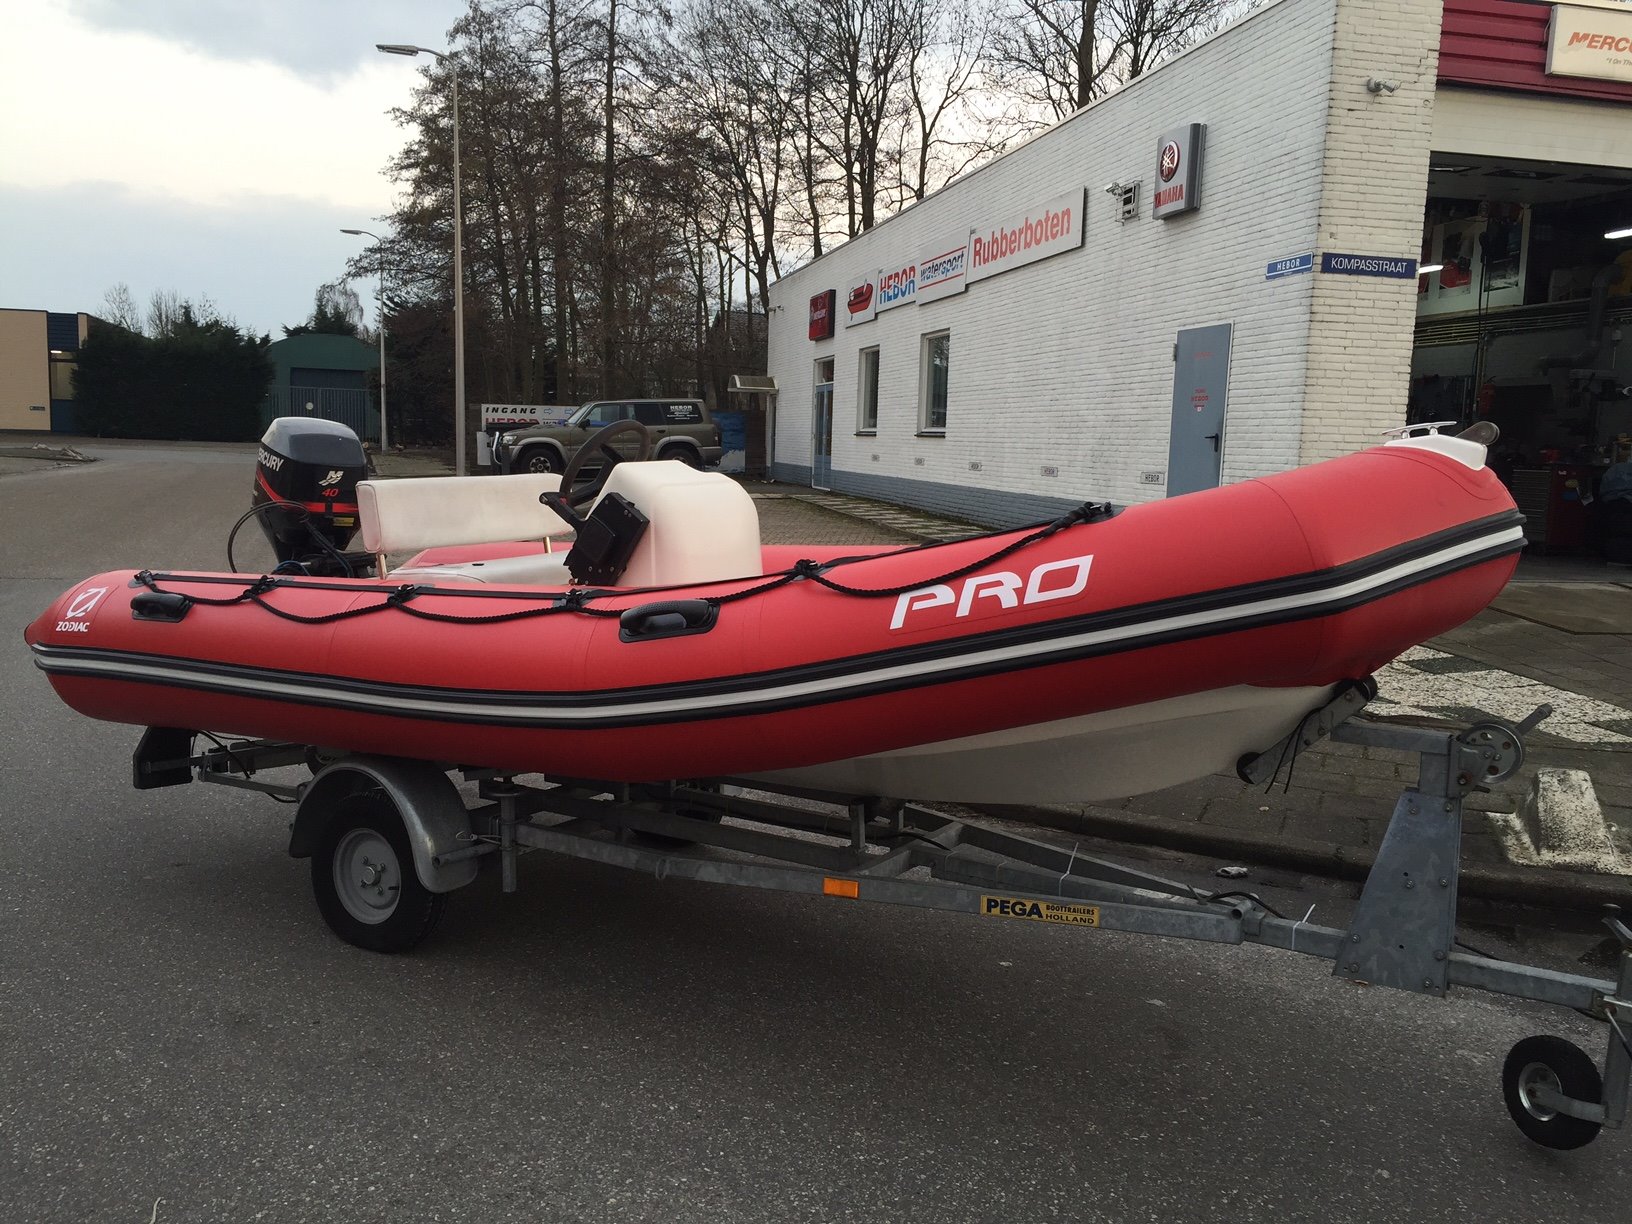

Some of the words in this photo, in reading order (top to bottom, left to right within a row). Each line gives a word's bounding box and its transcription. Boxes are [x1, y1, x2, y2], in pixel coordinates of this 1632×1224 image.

[1568, 31, 1632, 53] MERC
[973, 207, 1071, 268] Rubberboten
[920, 250, 965, 281] watersport
[1276, 258, 1300, 271] HEBOR
[1331, 257, 1408, 274] KOMPASSTRAAT
[880, 265, 916, 304] HEBOR
[485, 406, 537, 415] INGANG
[322, 488, 339, 497] 40
[889, 554, 1094, 629] PRO
[55, 621, 90, 632] ZODIAC
[986, 898, 1044, 919] PEGA
[1046, 904, 1095, 916] BOOTTRAILERS
[1045, 913, 1095, 924] HOLLAND
